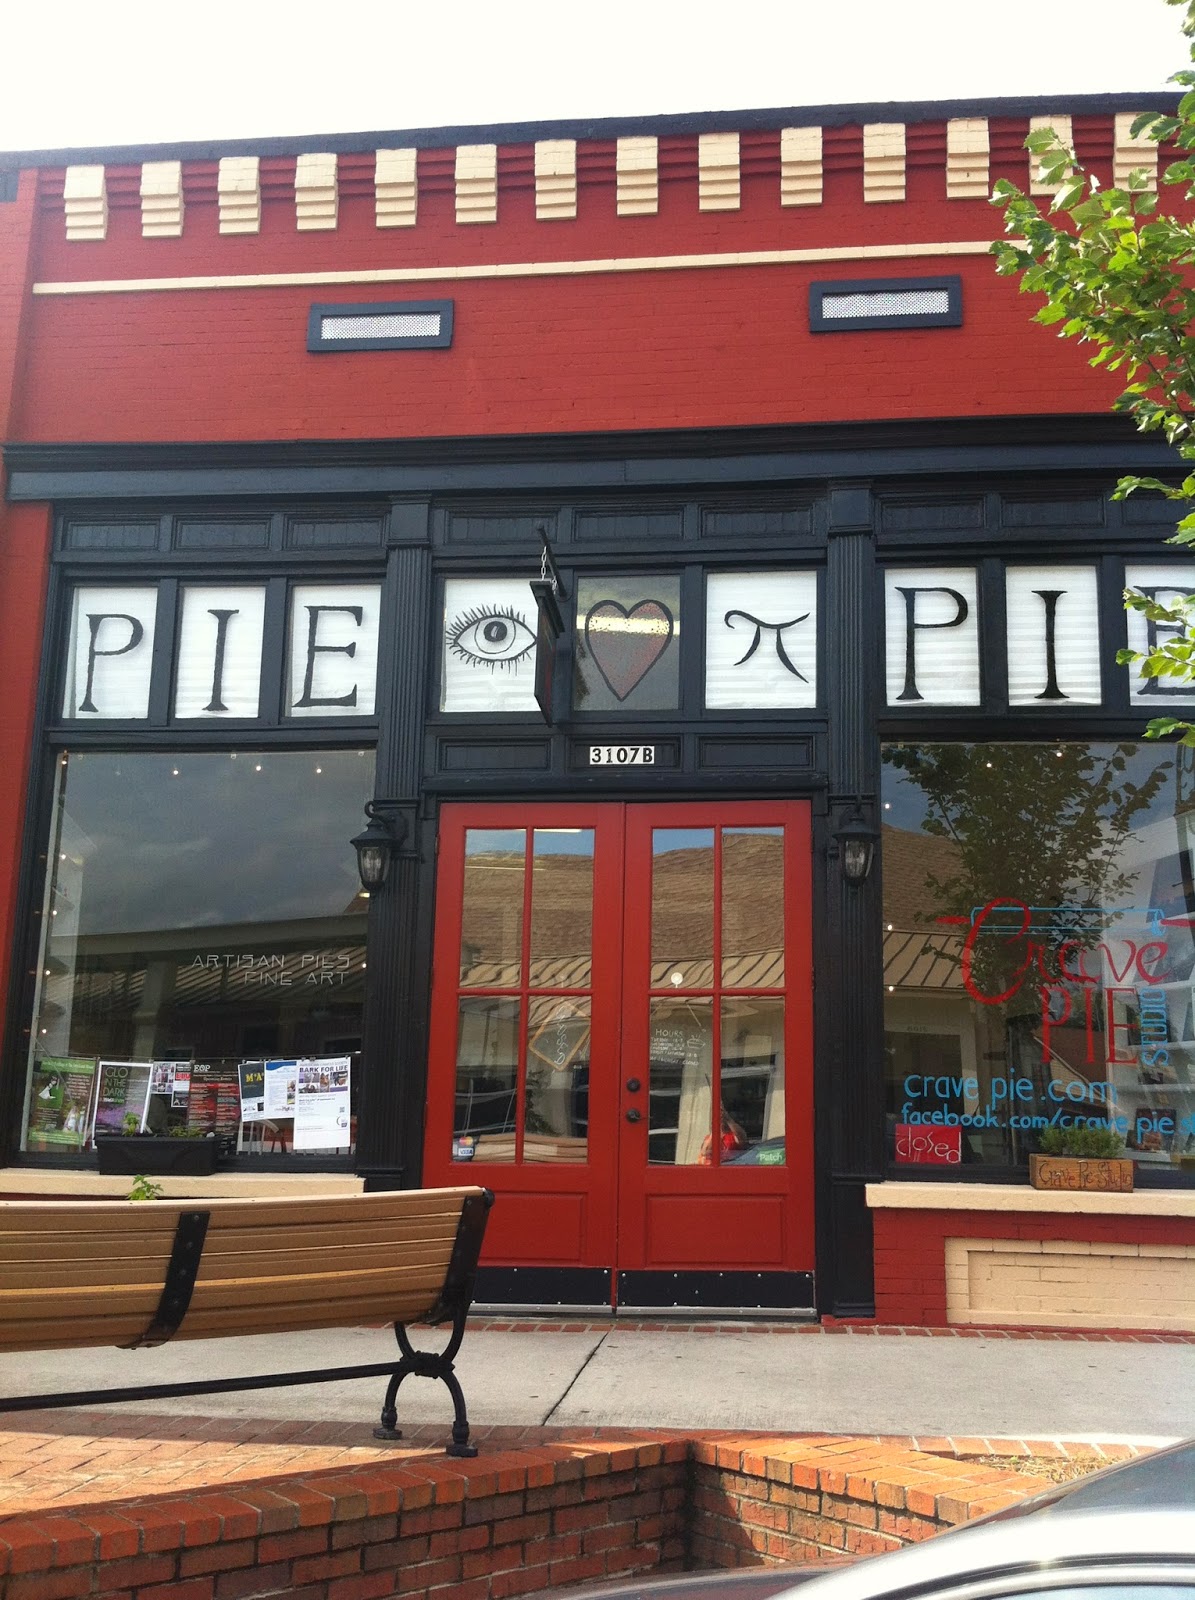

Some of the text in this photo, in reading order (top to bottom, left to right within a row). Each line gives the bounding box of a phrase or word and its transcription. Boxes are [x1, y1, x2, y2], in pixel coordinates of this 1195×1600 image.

[78, 605, 363, 712] PIE
[591, 747, 653, 764] 3107B
[191, 954, 350, 969] ARTISAN PIES
[961, 897, 1174, 1005] Crave
[244, 971, 350, 986] FINE ART
[1038, 985, 1138, 1064] PIE
[1140, 987, 1169, 1067] STUDIO
[105, 1066, 129, 1079] GLO
[103, 1088, 125, 1097] DARK
[904, 1074, 979, 1099] crave
[1136, 1111, 1175, 1145] pie
[896, 1126, 962, 1164] closed
[1039, 1162, 1076, 1187] Crave
